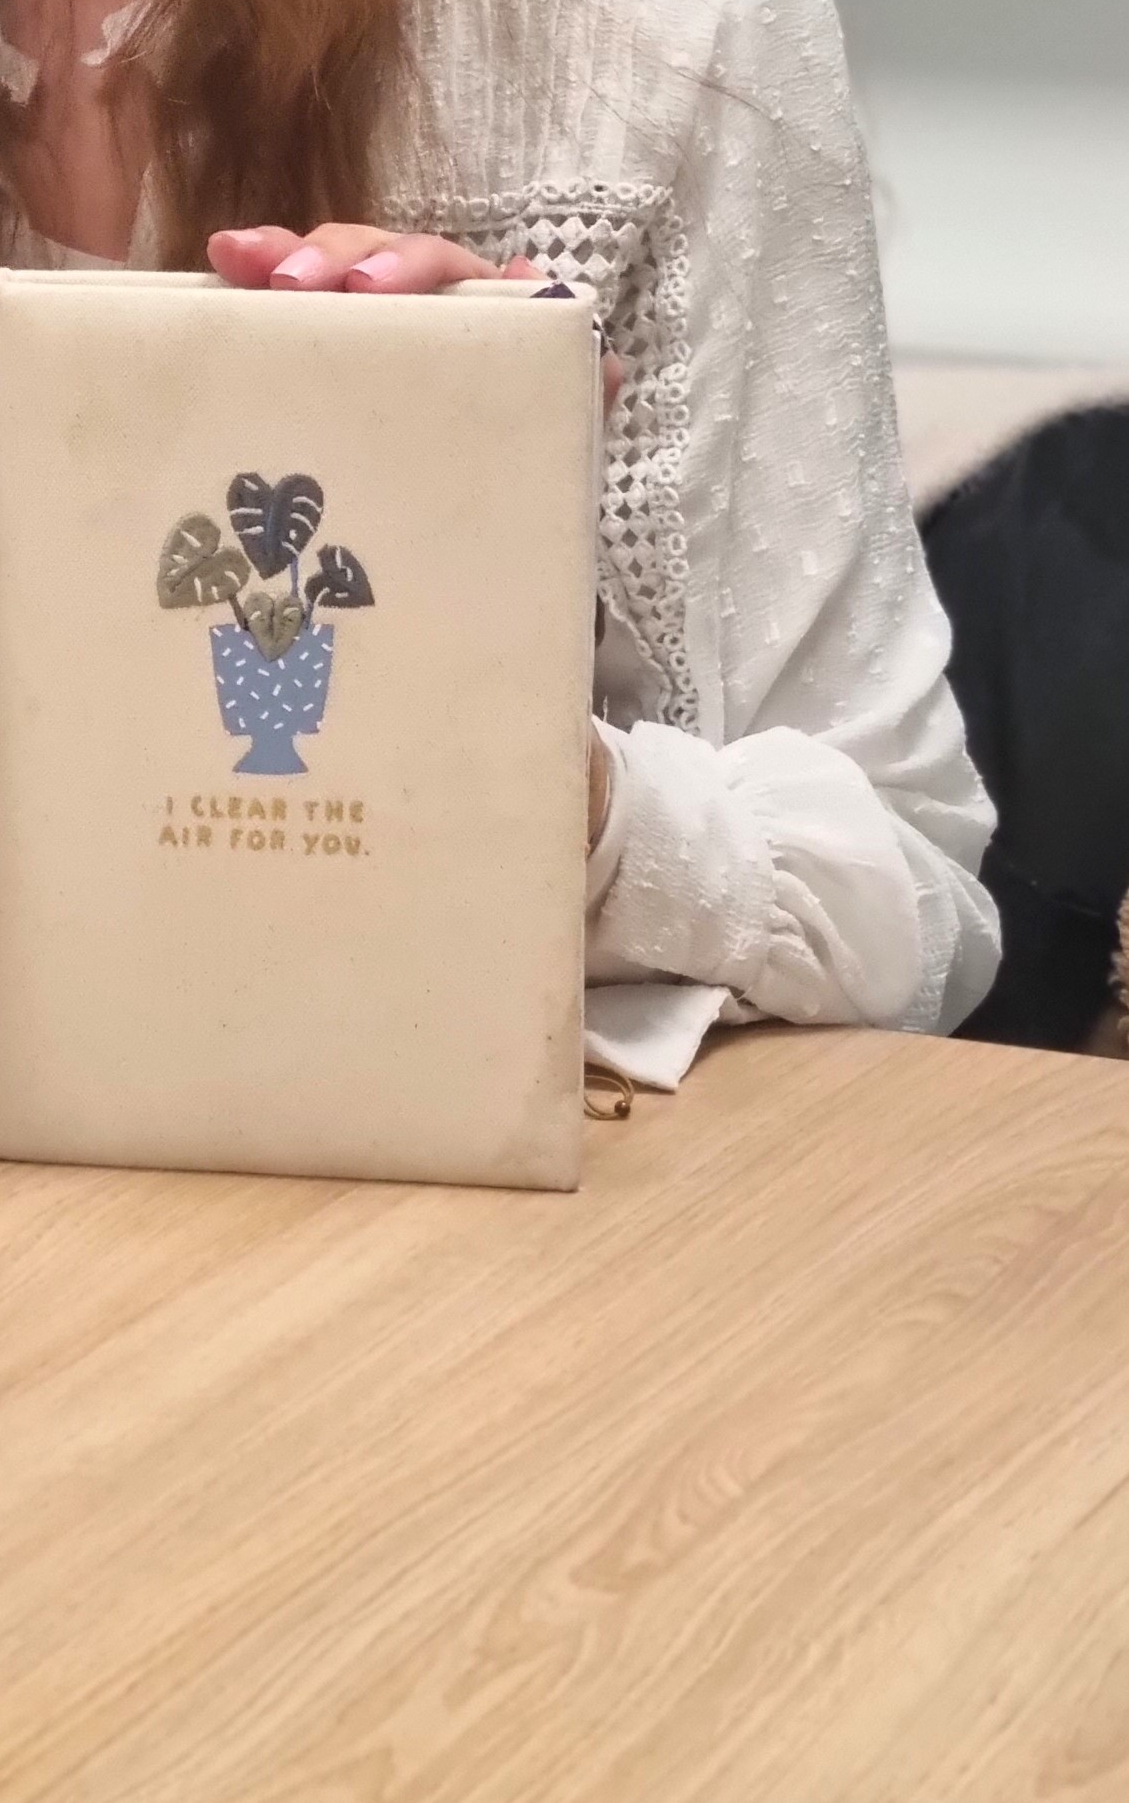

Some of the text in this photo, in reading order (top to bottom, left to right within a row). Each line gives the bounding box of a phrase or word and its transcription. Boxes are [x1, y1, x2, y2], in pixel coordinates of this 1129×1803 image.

[165, 795, 365, 824] I CLEAR THE
[158, 825, 370, 856] AIR FOR YOU.
